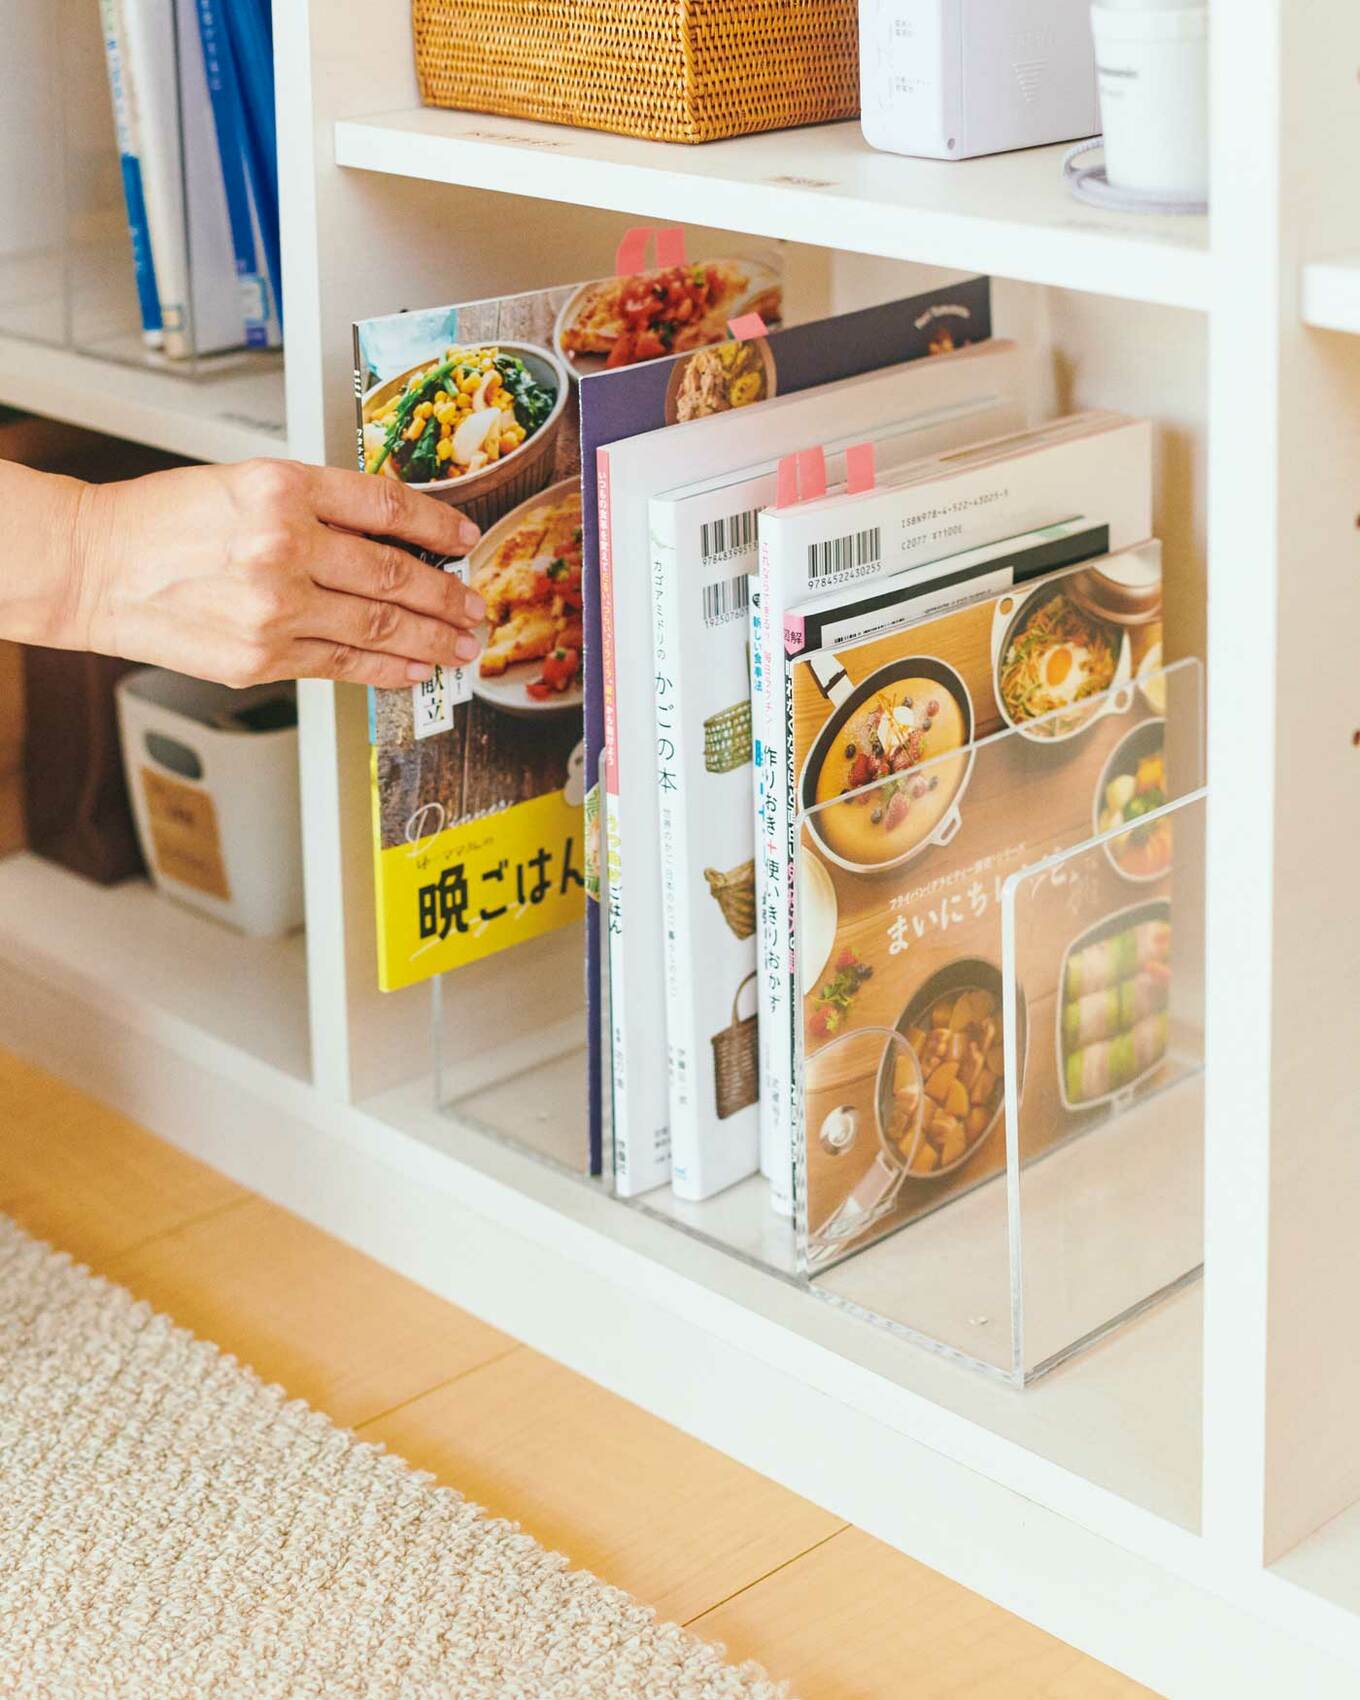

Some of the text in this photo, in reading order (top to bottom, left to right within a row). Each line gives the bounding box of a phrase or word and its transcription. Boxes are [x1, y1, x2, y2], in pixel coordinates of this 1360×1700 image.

[807, 561, 883, 591] 9784522430255
[655, 672, 678, 793] かごの本
[418, 836, 585, 940] 晩ごはん
